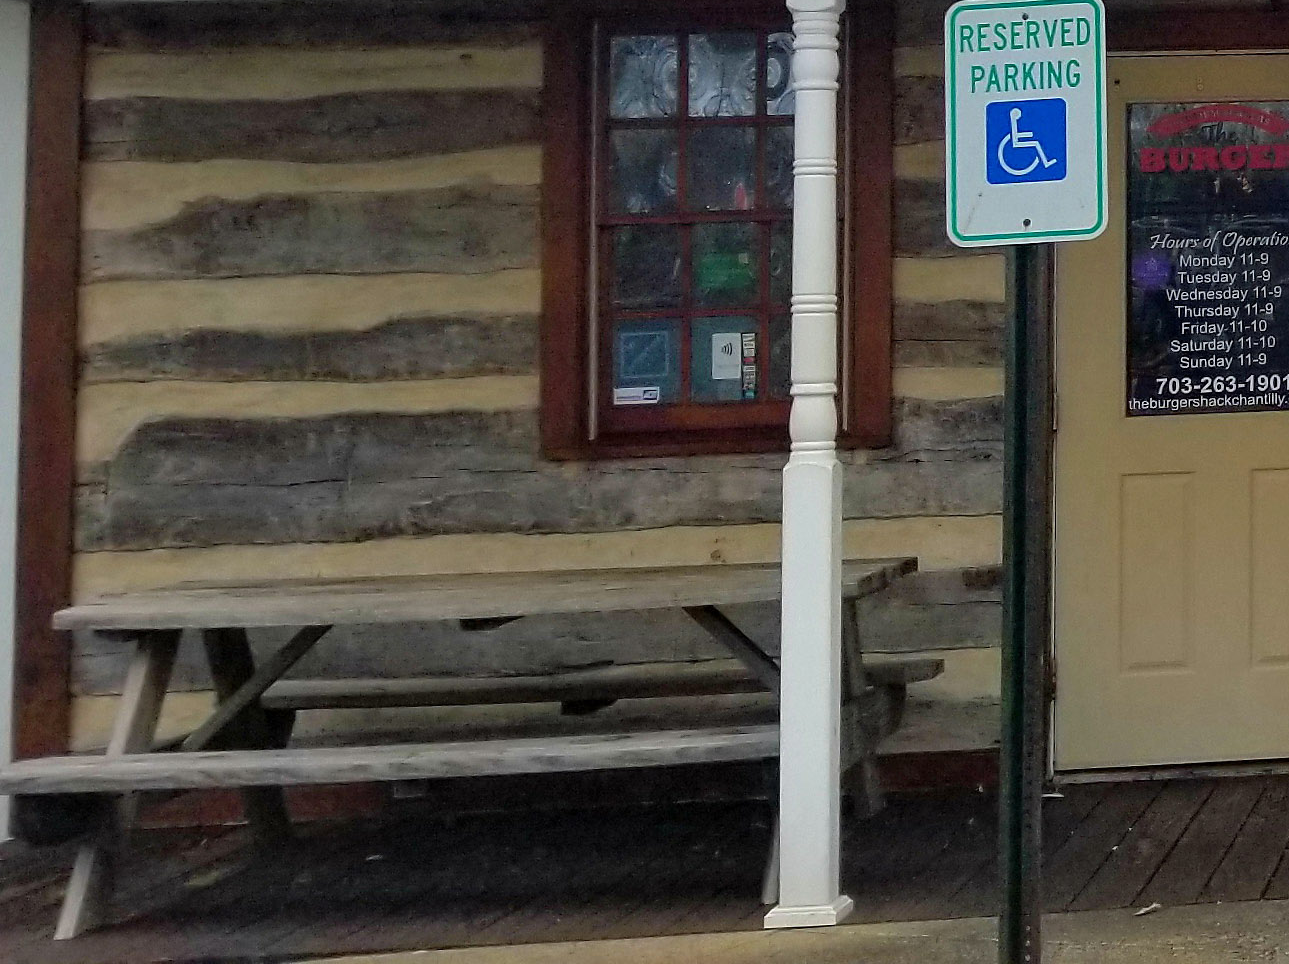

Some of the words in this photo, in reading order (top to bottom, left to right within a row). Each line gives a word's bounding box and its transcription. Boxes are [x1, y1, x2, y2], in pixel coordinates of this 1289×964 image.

[959, 17, 1091, 53] RESERVED
[970, 59, 1081, 93] PARKING
[1150, 233, 1199, 249] Hours
[1202, 230, 1221, 252] of
[1179, 254, 1235, 268] Monday
[1239, 252, 1269, 265] 11-9
[1177, 271, 1237, 285] Tuesday
[1242, 269, 1271, 282] 11-9
[1166, 288, 1248, 302] Wednesday
[1253, 285, 1282, 298] 11-9
[1174, 304, 1239, 318] Thursday
[1244, 302, 1274, 315] 11-9
[1181, 322, 1225, 336] Friday
[1229, 319, 1267, 333] 11-10
[1170, 338, 1233, 353] Saturday
[1237, 336, 1276, 349] 11-10
[1179, 355, 1233, 369] Sunday
[1237, 353, 1267, 366] 11-9
